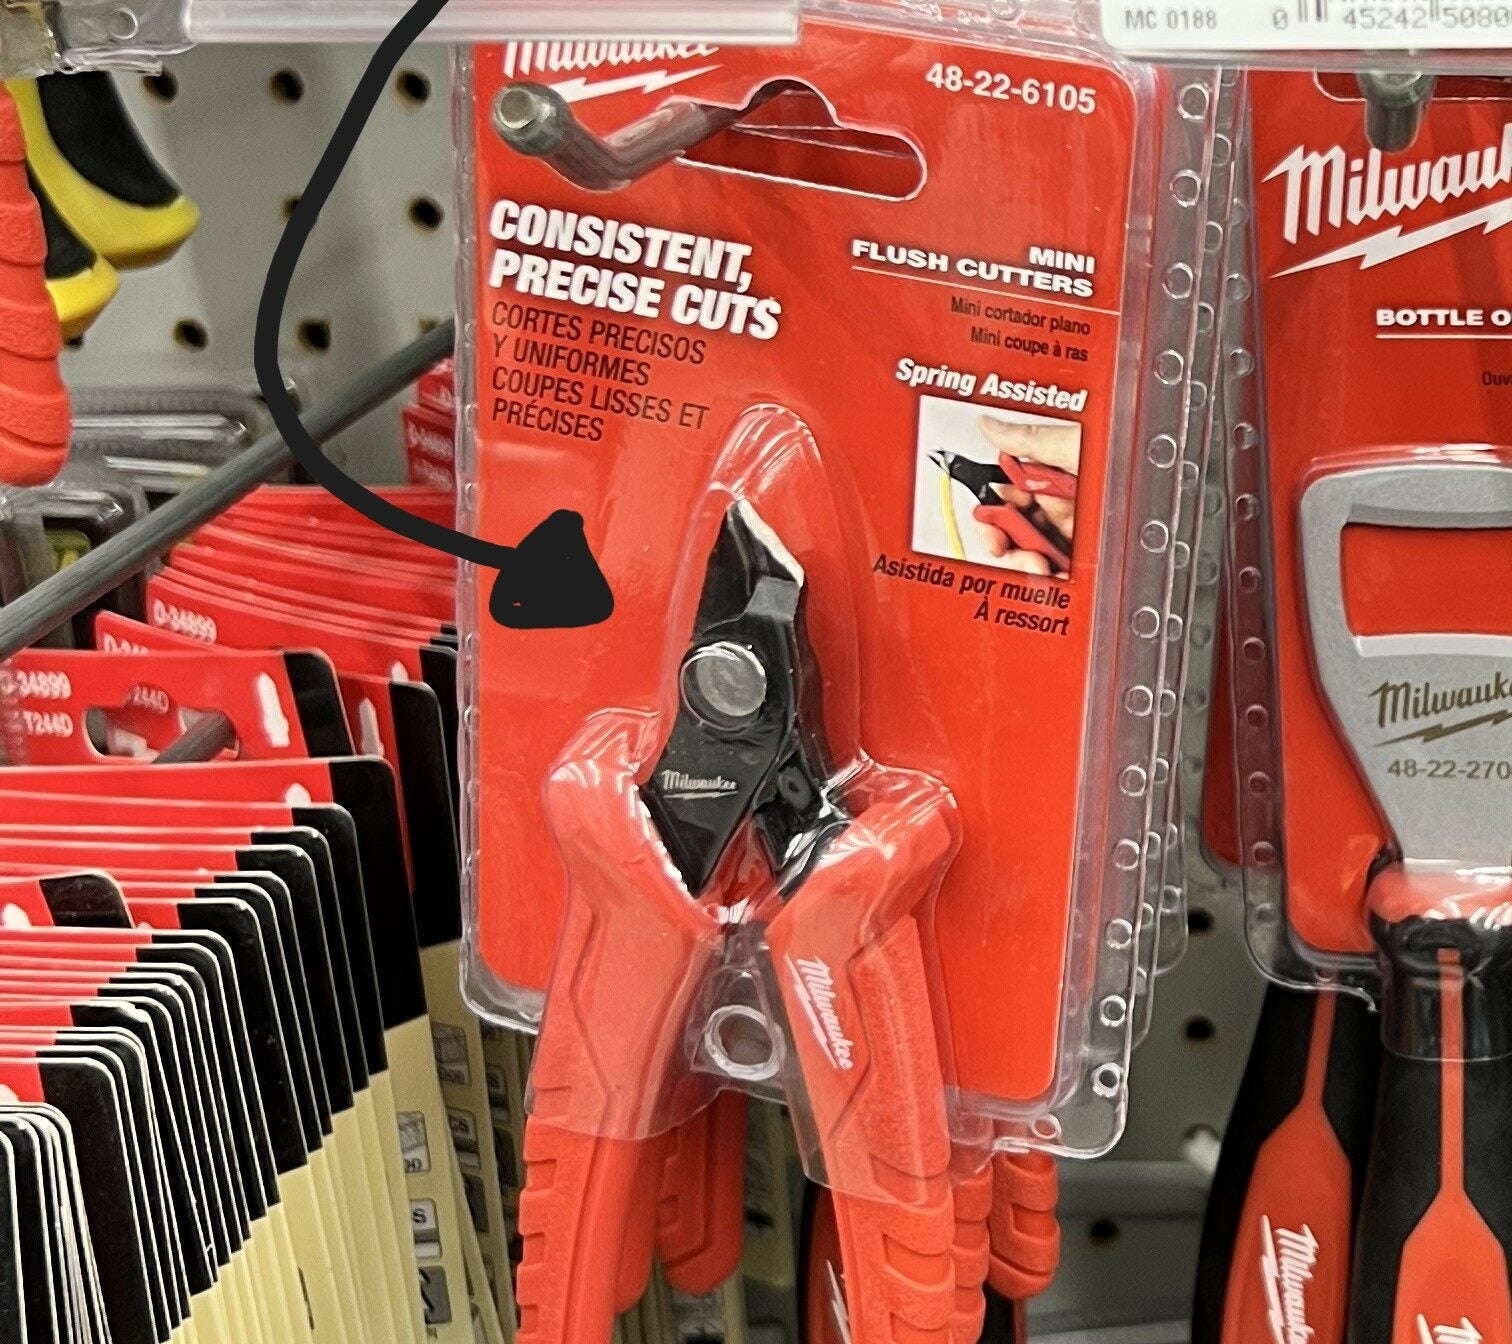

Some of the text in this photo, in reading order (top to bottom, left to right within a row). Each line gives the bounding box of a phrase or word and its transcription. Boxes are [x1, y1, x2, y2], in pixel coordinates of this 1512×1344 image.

[1126, 10, 1217, 30] MC 0188
[925, 62, 1096, 114] 48-22-6105
[489, 199, 753, 291] CONSISTENT,
[852, 239, 1094, 298] FLUSH CUTTERS
[1029, 246, 1095, 274] MINI
[489, 250, 782, 341] PRECISE CUTS
[951, 296, 1091, 336] Mini cortador plano
[1376, 308, 1485, 327] BOTTLE
[492, 301, 706, 366] CORTES PRECISOS
[970, 325, 999, 346] Mini
[1002, 331, 1049, 357] coupe
[1065, 345, 1089, 362] ras
[492, 335, 651, 387] Y UNIFORMES
[896, 358, 1087, 412] Spring Assisted
[491, 367, 710, 431] COUPES LISSES ET
[491, 394, 604, 443] PRÉCISES
[873, 554, 1071, 609] Asistida por muelle
[974, 596, 1070, 638] À ressort
[661, 769, 738, 792] Milwaukee
[795, 955, 854, 1070] Milwaukee
